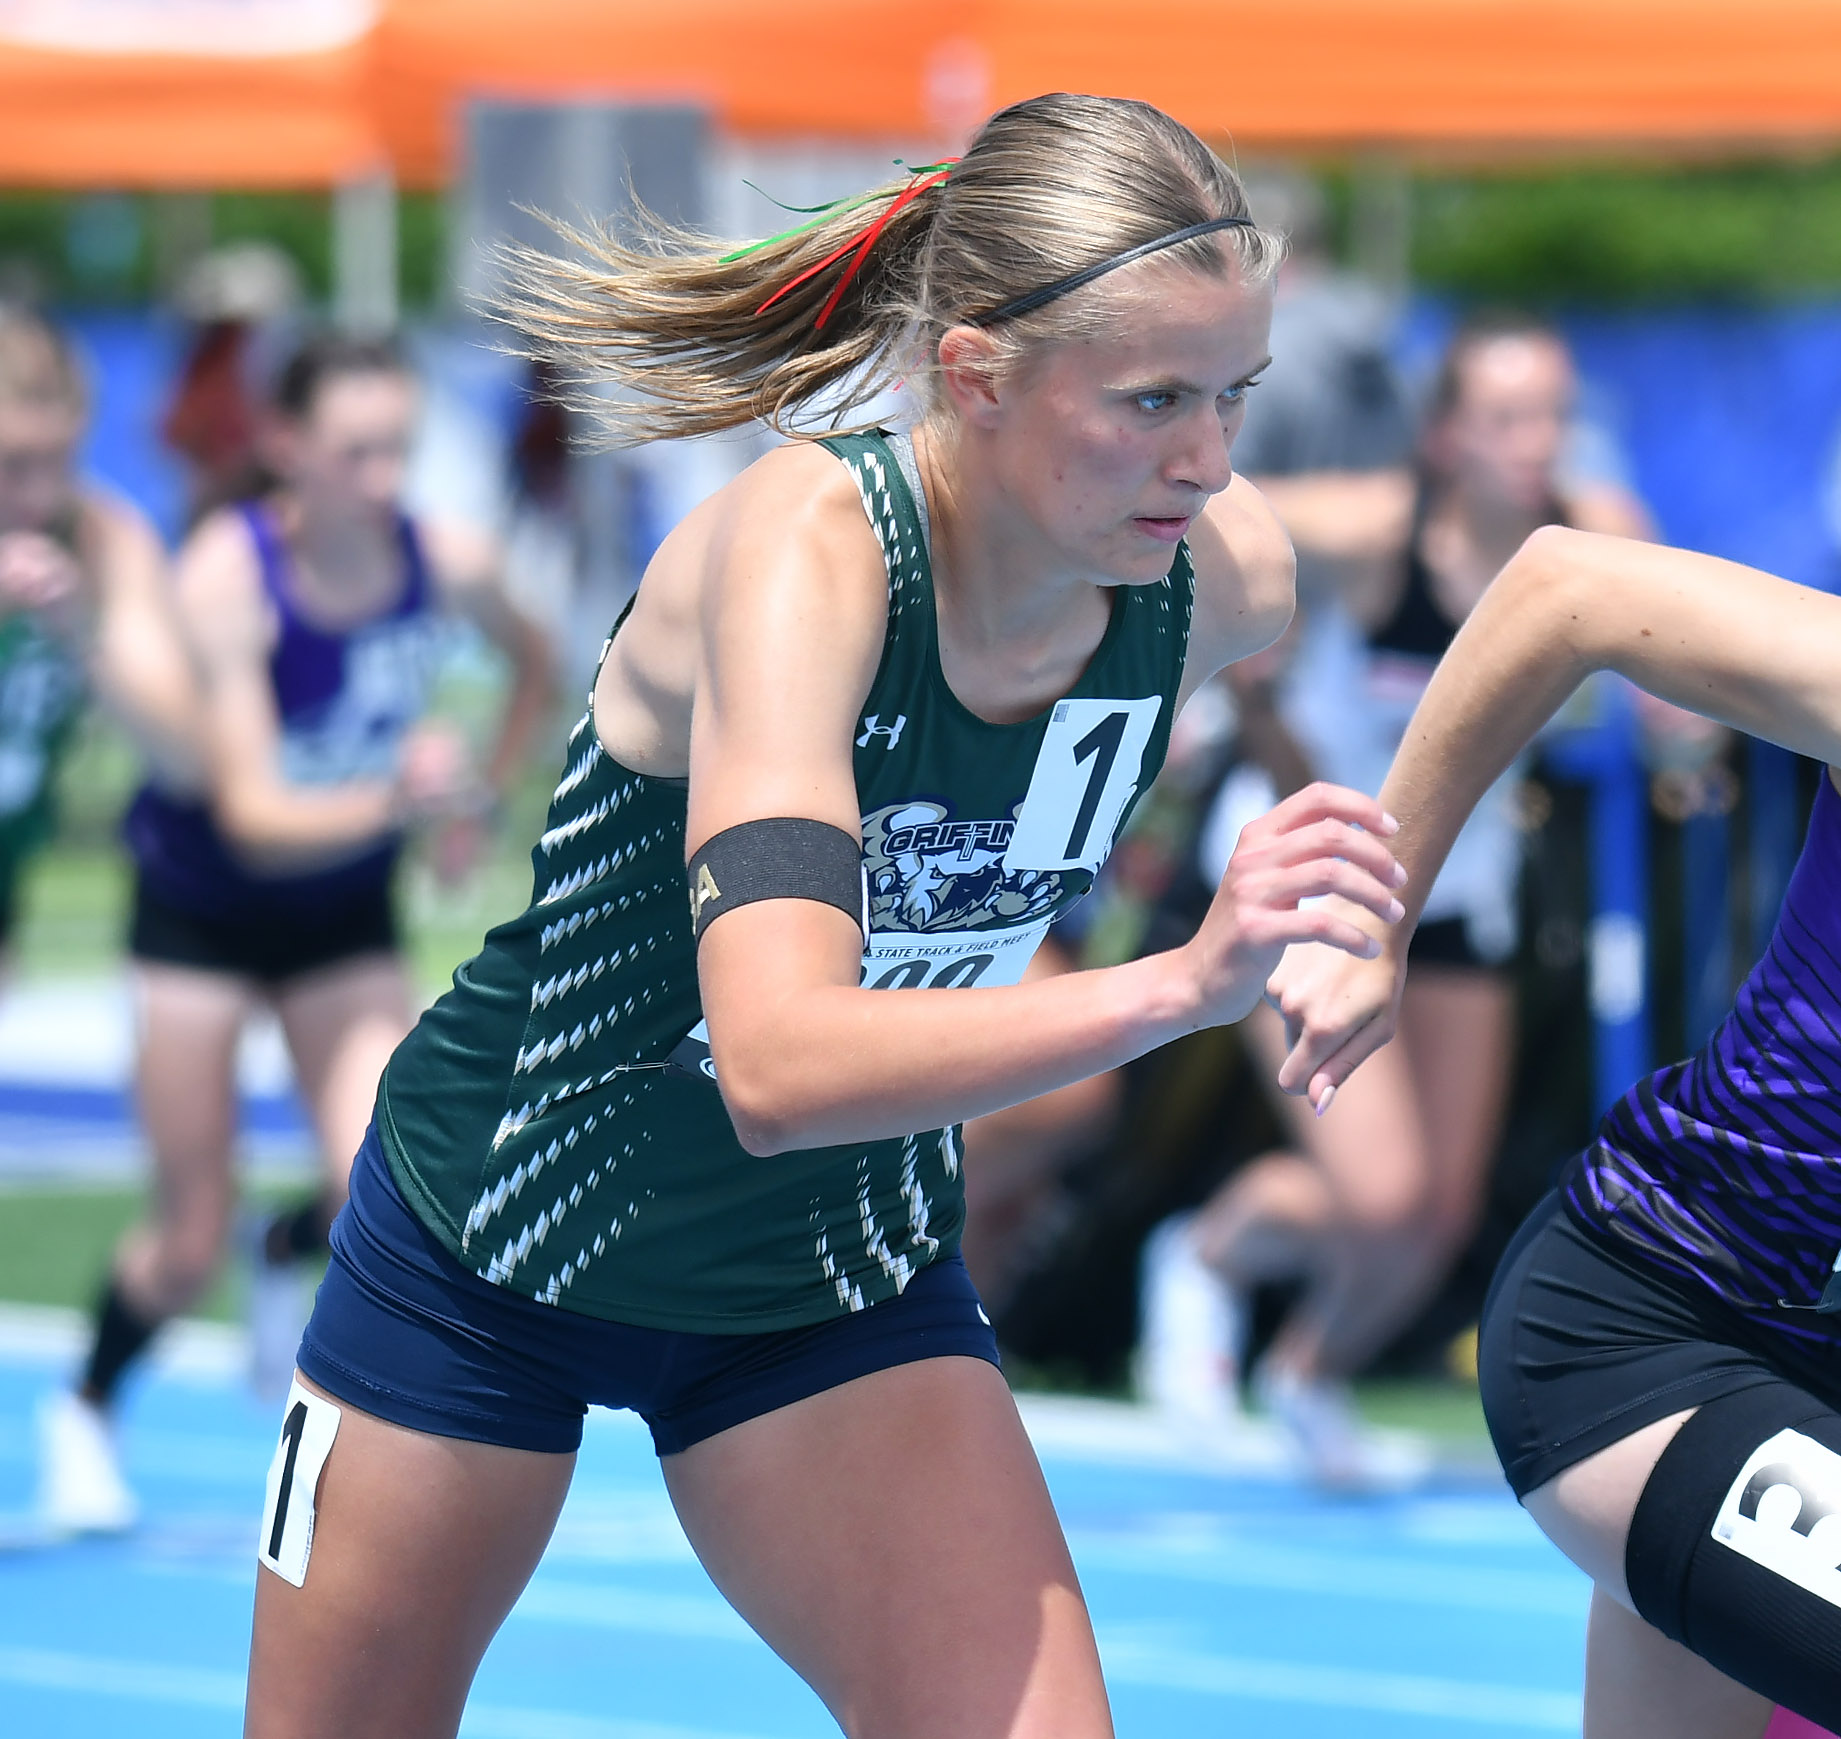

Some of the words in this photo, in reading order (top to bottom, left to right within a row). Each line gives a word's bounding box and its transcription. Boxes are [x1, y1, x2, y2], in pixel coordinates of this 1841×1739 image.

[1063, 712, 1130, 860] 1
[876, 948, 913, 958] STATE
[916, 946, 951, 957] TRACK
[966, 939, 998, 952] FIELD
[269, 1400, 308, 1561] 1
